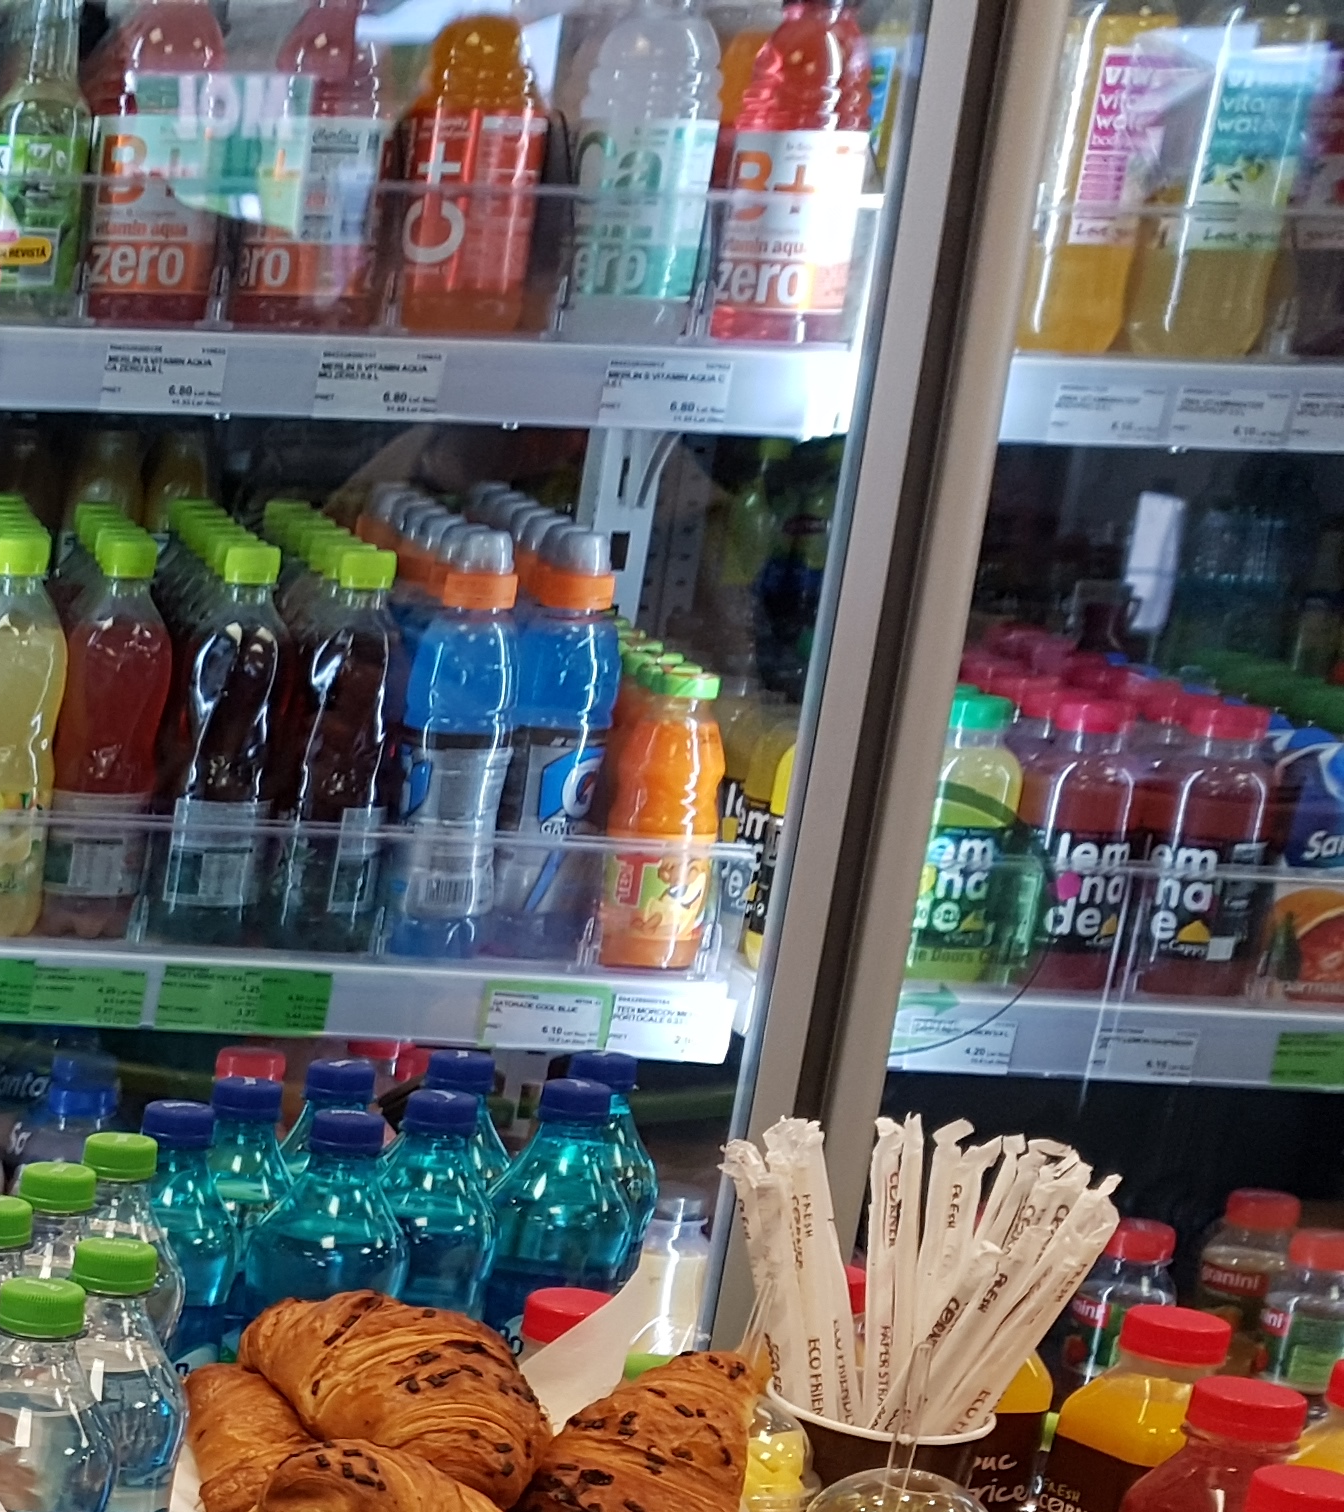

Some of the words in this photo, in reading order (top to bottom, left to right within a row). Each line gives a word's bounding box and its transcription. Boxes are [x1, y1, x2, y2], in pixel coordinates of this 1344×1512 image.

[90, 246, 185, 288] zero
[713, 262, 812, 305] zero
[168, 385, 193, 397] 6.80
[383, 391, 408, 403] 6.80
[670, 401, 695, 413] 6.80
[1055, 832, 1131, 873] lem
[1044, 896, 1102, 938] de
[802, 1193, 814, 1239] FRESH
[807, 1337, 823, 1372] ECO
[1043, 1476, 1082, 1504] FRESH
